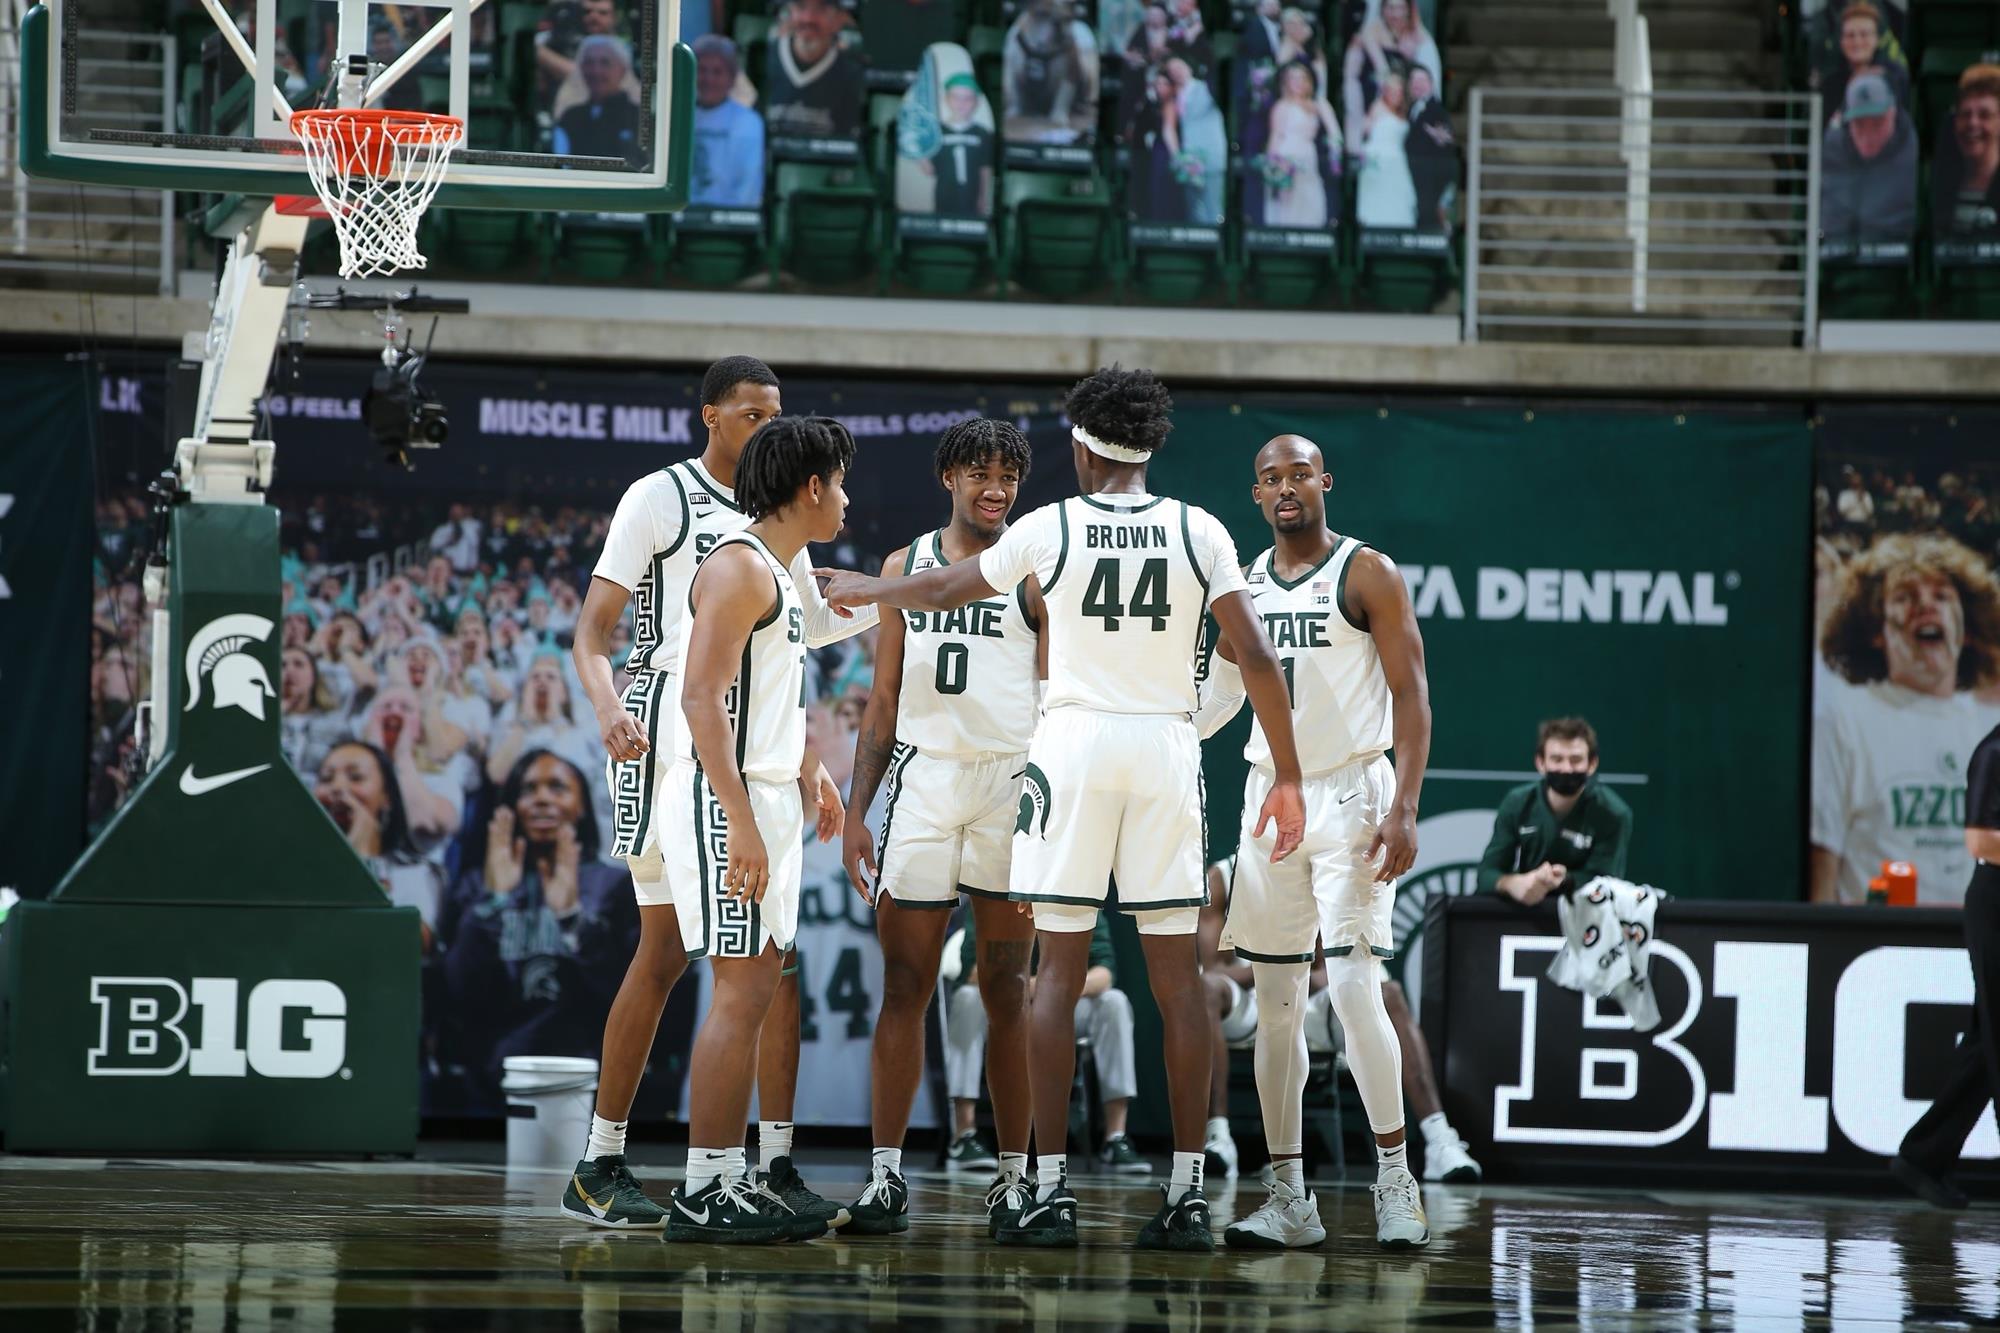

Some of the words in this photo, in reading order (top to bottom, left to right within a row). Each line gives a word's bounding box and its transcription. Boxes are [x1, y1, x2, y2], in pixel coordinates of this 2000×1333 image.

[480, 398, 606, 438] MUSCLE
[611, 405, 691, 443] MILK
[1086, 524, 1167, 549] BROWN
[1082, 558, 1171, 631] 44
[1257, 612, 1332, 648] TATE
[935, 642, 969, 695] 0
